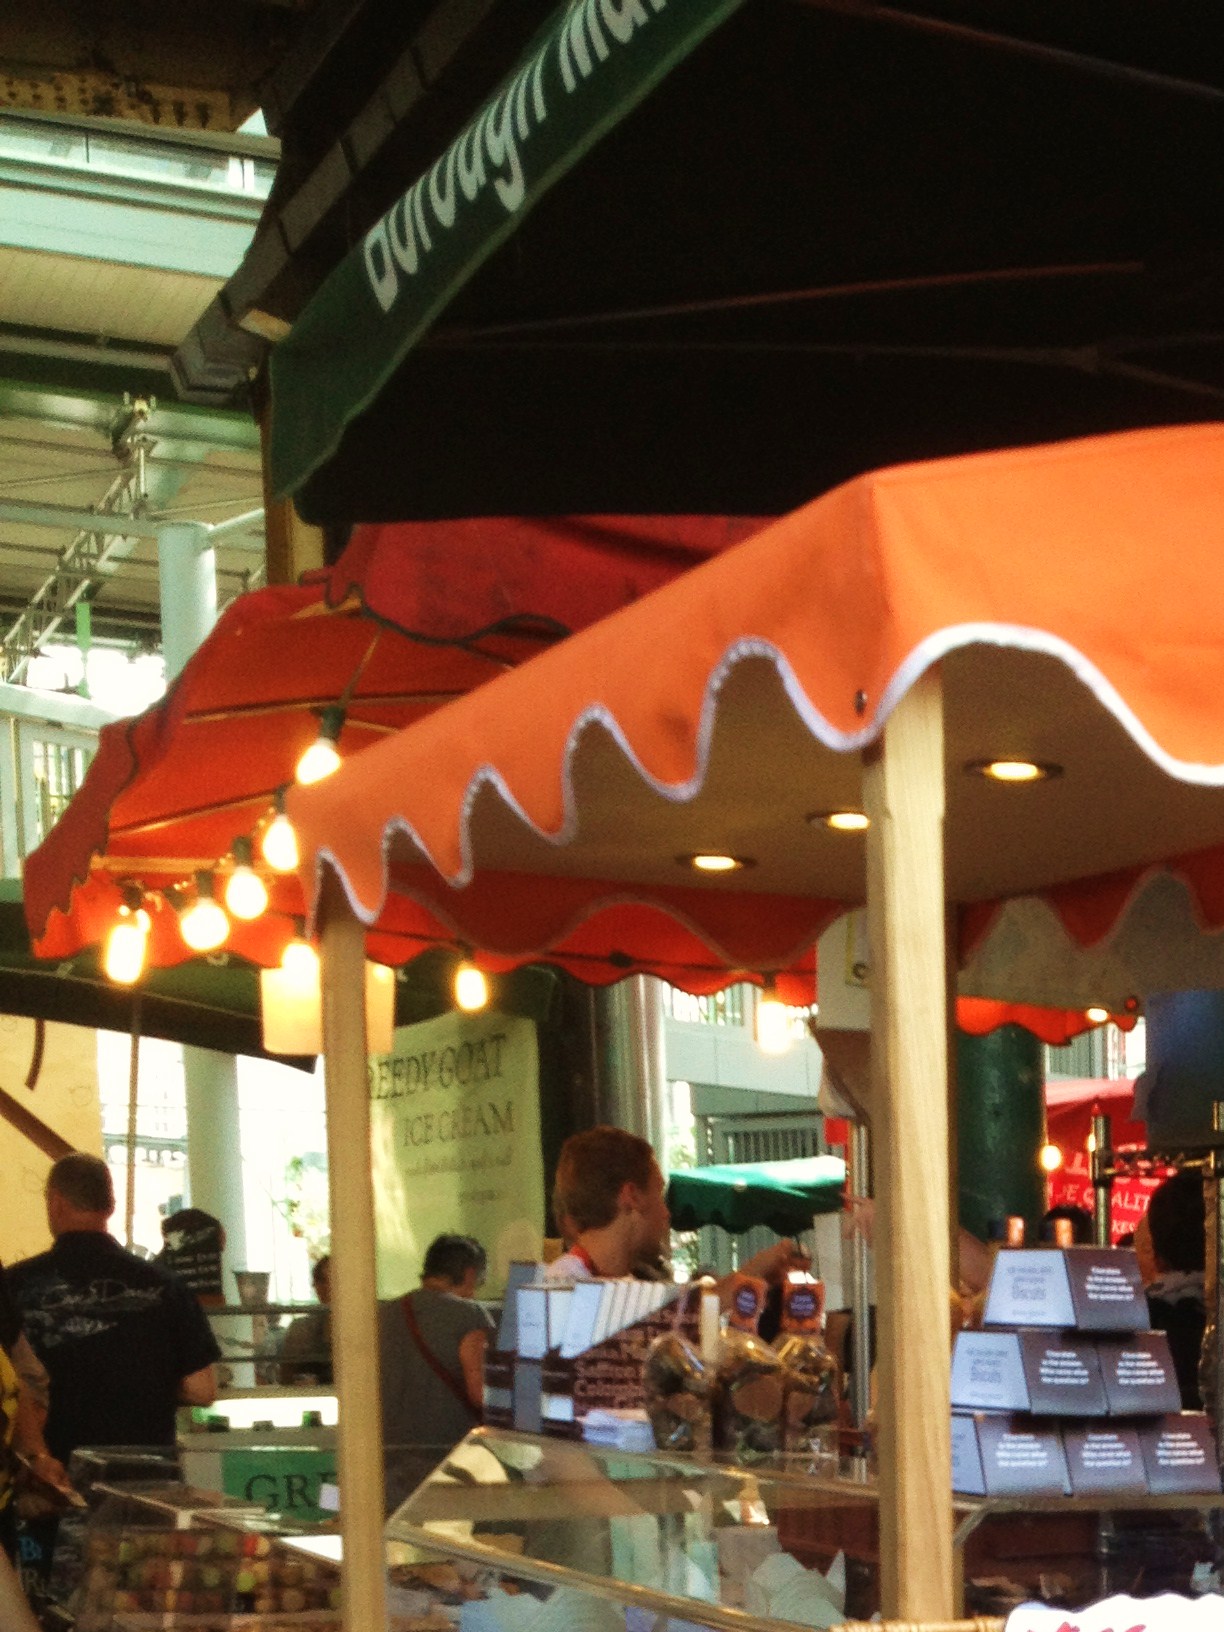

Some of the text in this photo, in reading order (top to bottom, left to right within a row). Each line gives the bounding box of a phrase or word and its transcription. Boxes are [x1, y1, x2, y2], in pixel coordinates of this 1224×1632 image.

[439, 1032, 507, 1090] GOAT
[403, 1100, 514, 1147] ICE CREAM
